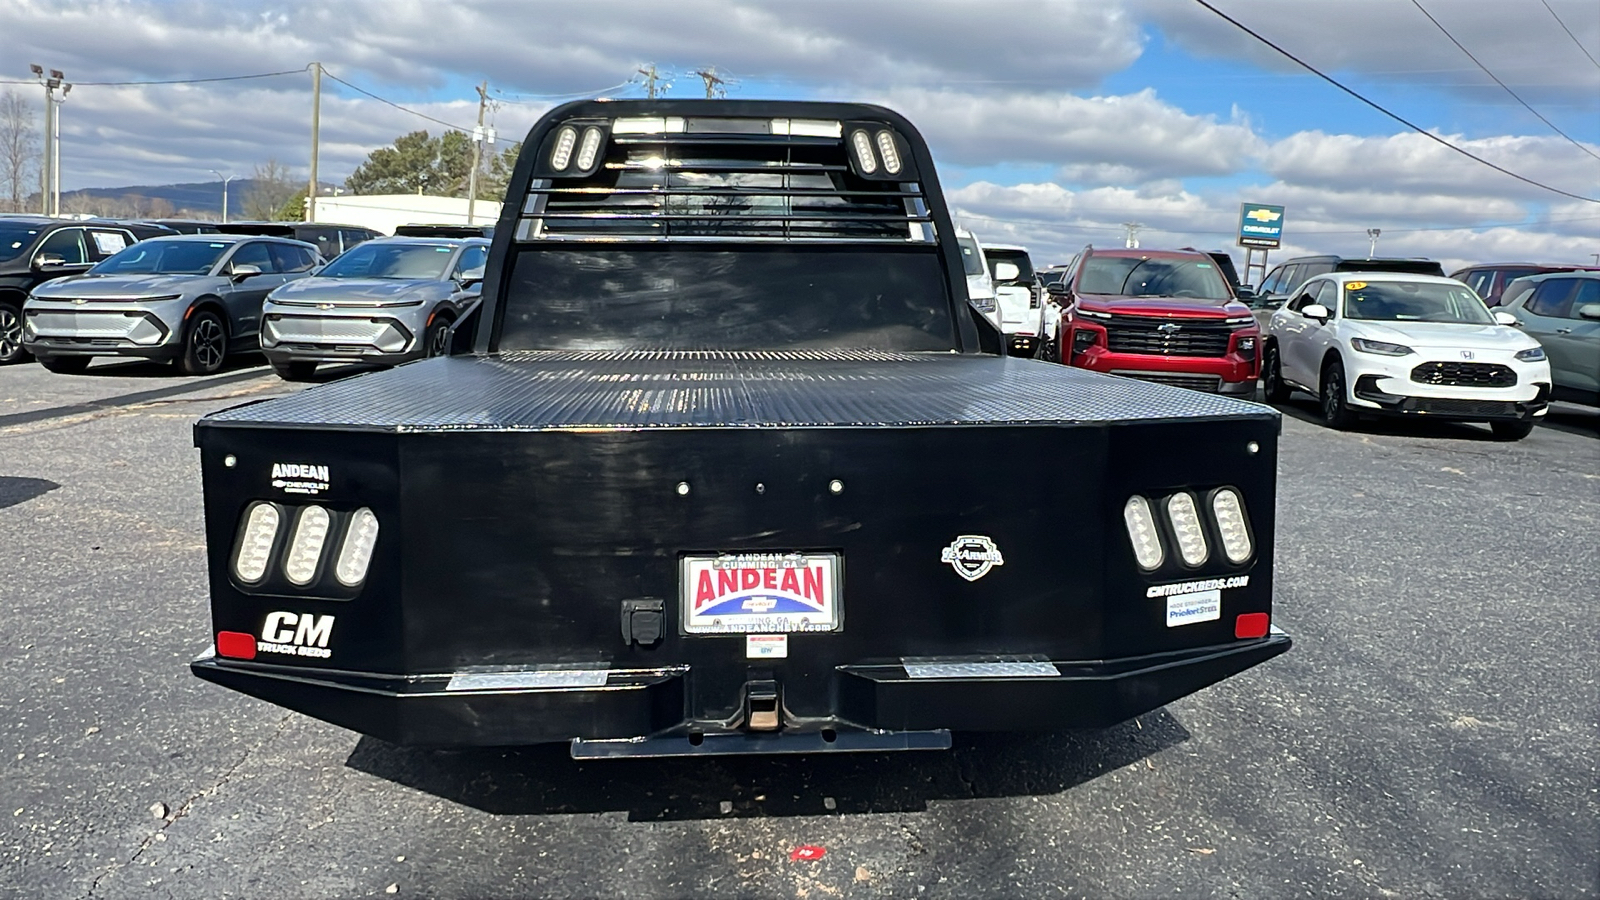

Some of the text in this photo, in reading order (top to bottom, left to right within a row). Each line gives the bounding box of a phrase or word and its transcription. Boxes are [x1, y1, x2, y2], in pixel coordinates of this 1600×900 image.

[271, 463, 330, 482] ANDEAN
[722, 561, 798, 570] CUMMING, GA
[738, 553, 783, 561] ANDEAN
[694, 566, 825, 610] ANDEAN
[1147, 576, 1249, 597] CMTRUCKBEDS.COM
[261, 611, 336, 648] CM
[257, 641, 332, 658] TRUCK BEDS
